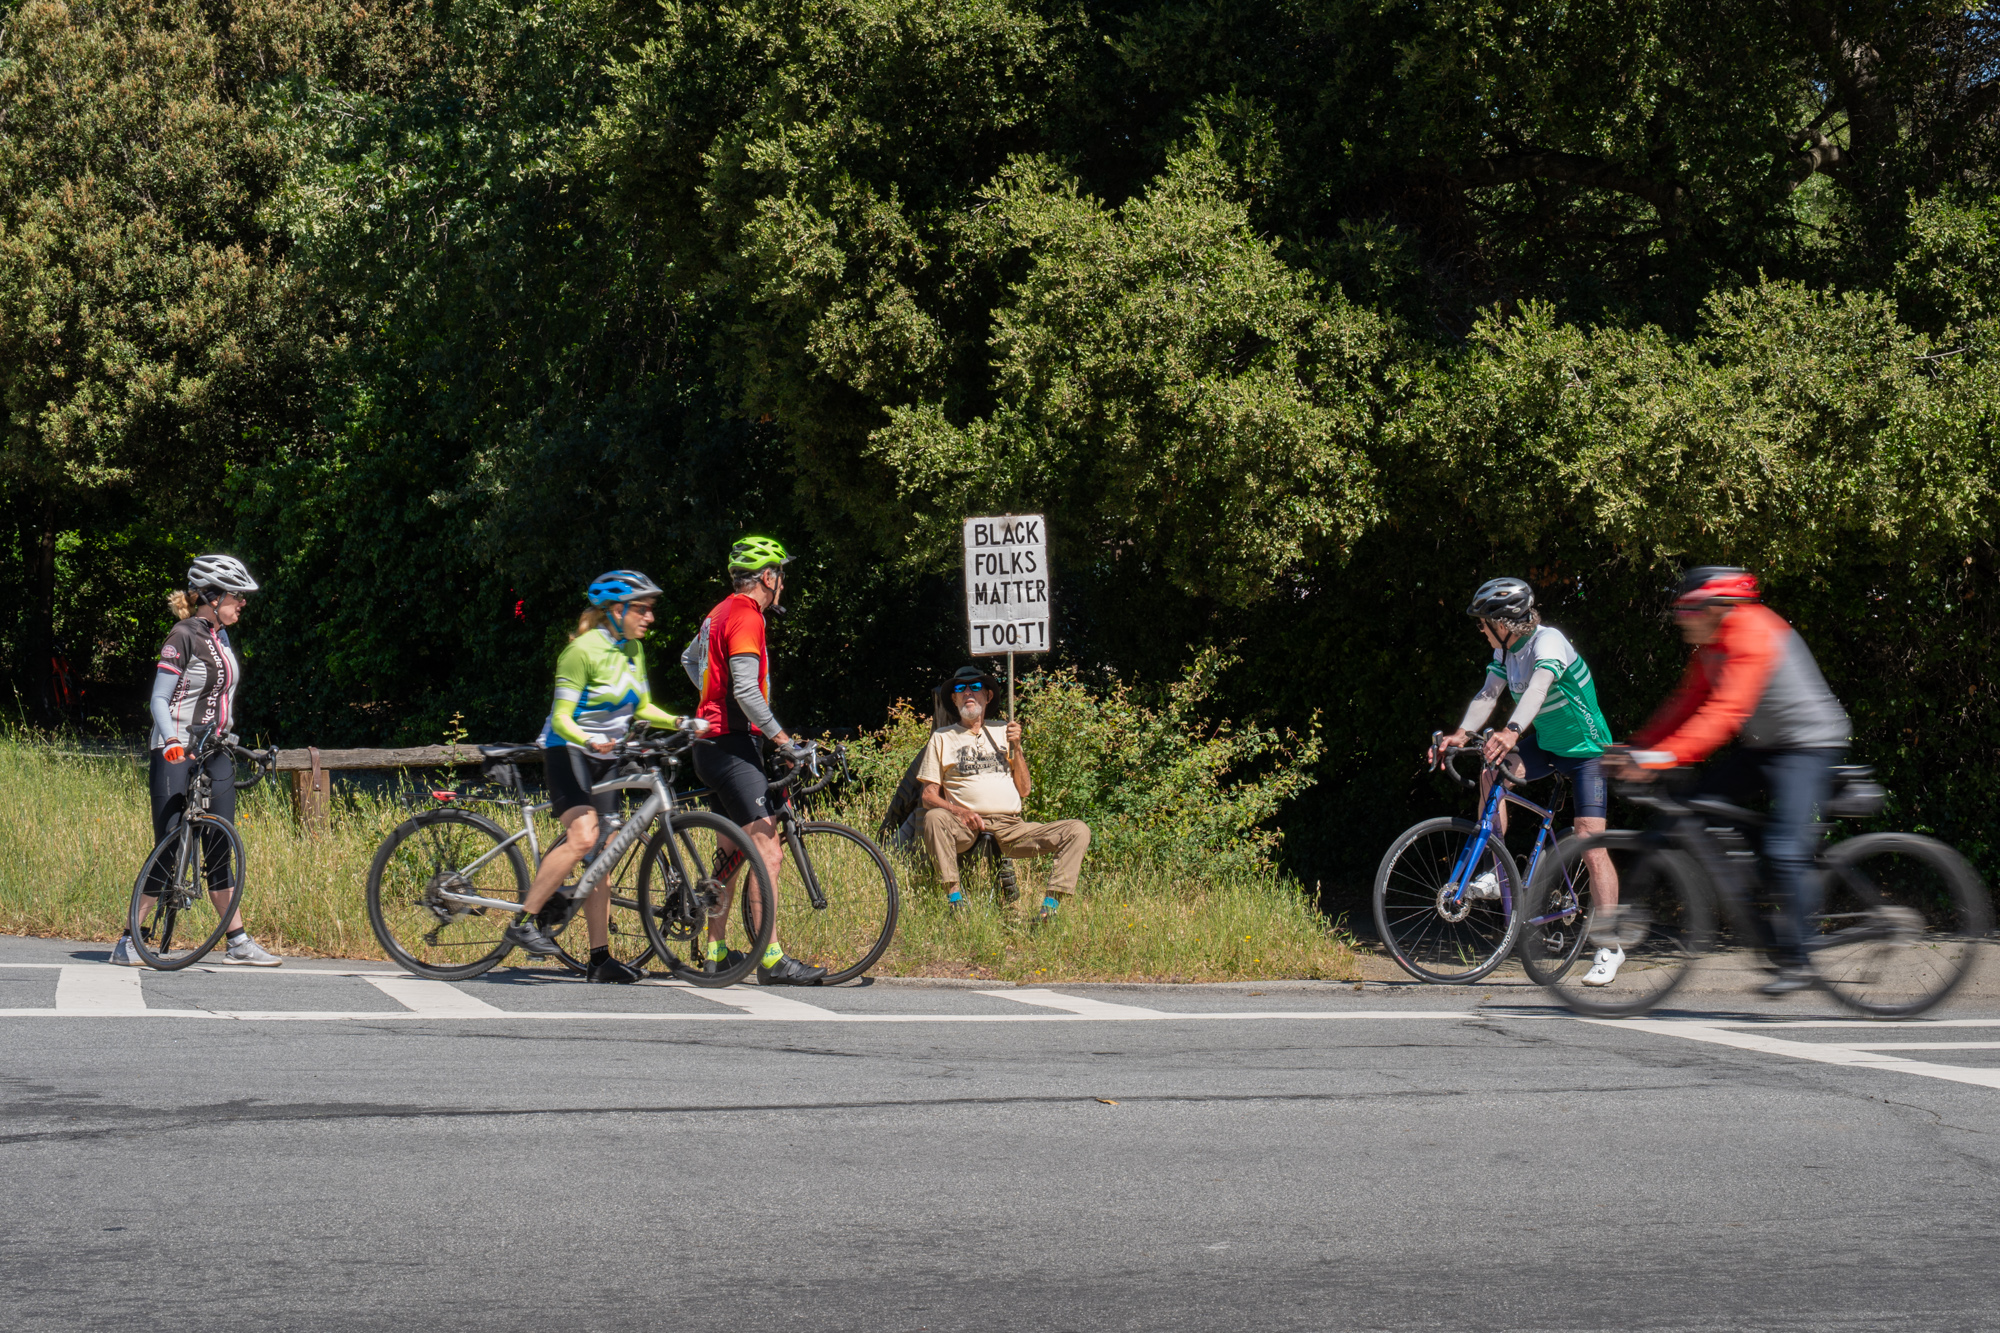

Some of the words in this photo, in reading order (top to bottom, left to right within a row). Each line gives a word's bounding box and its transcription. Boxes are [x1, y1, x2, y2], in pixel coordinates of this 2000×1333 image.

[975, 521, 1039, 546] BLACK
[975, 551, 1037, 576] FOLKS
[975, 579, 1047, 605] MATTER
[974, 621, 1044, 647] TOOT!
[205, 639, 223, 668] aptos
[207, 669, 224, 706] station
[201, 708, 215, 724] ike
[1573, 695, 1599, 740] BACKROADS
[585, 815, 646, 884] SPECIALIZED
